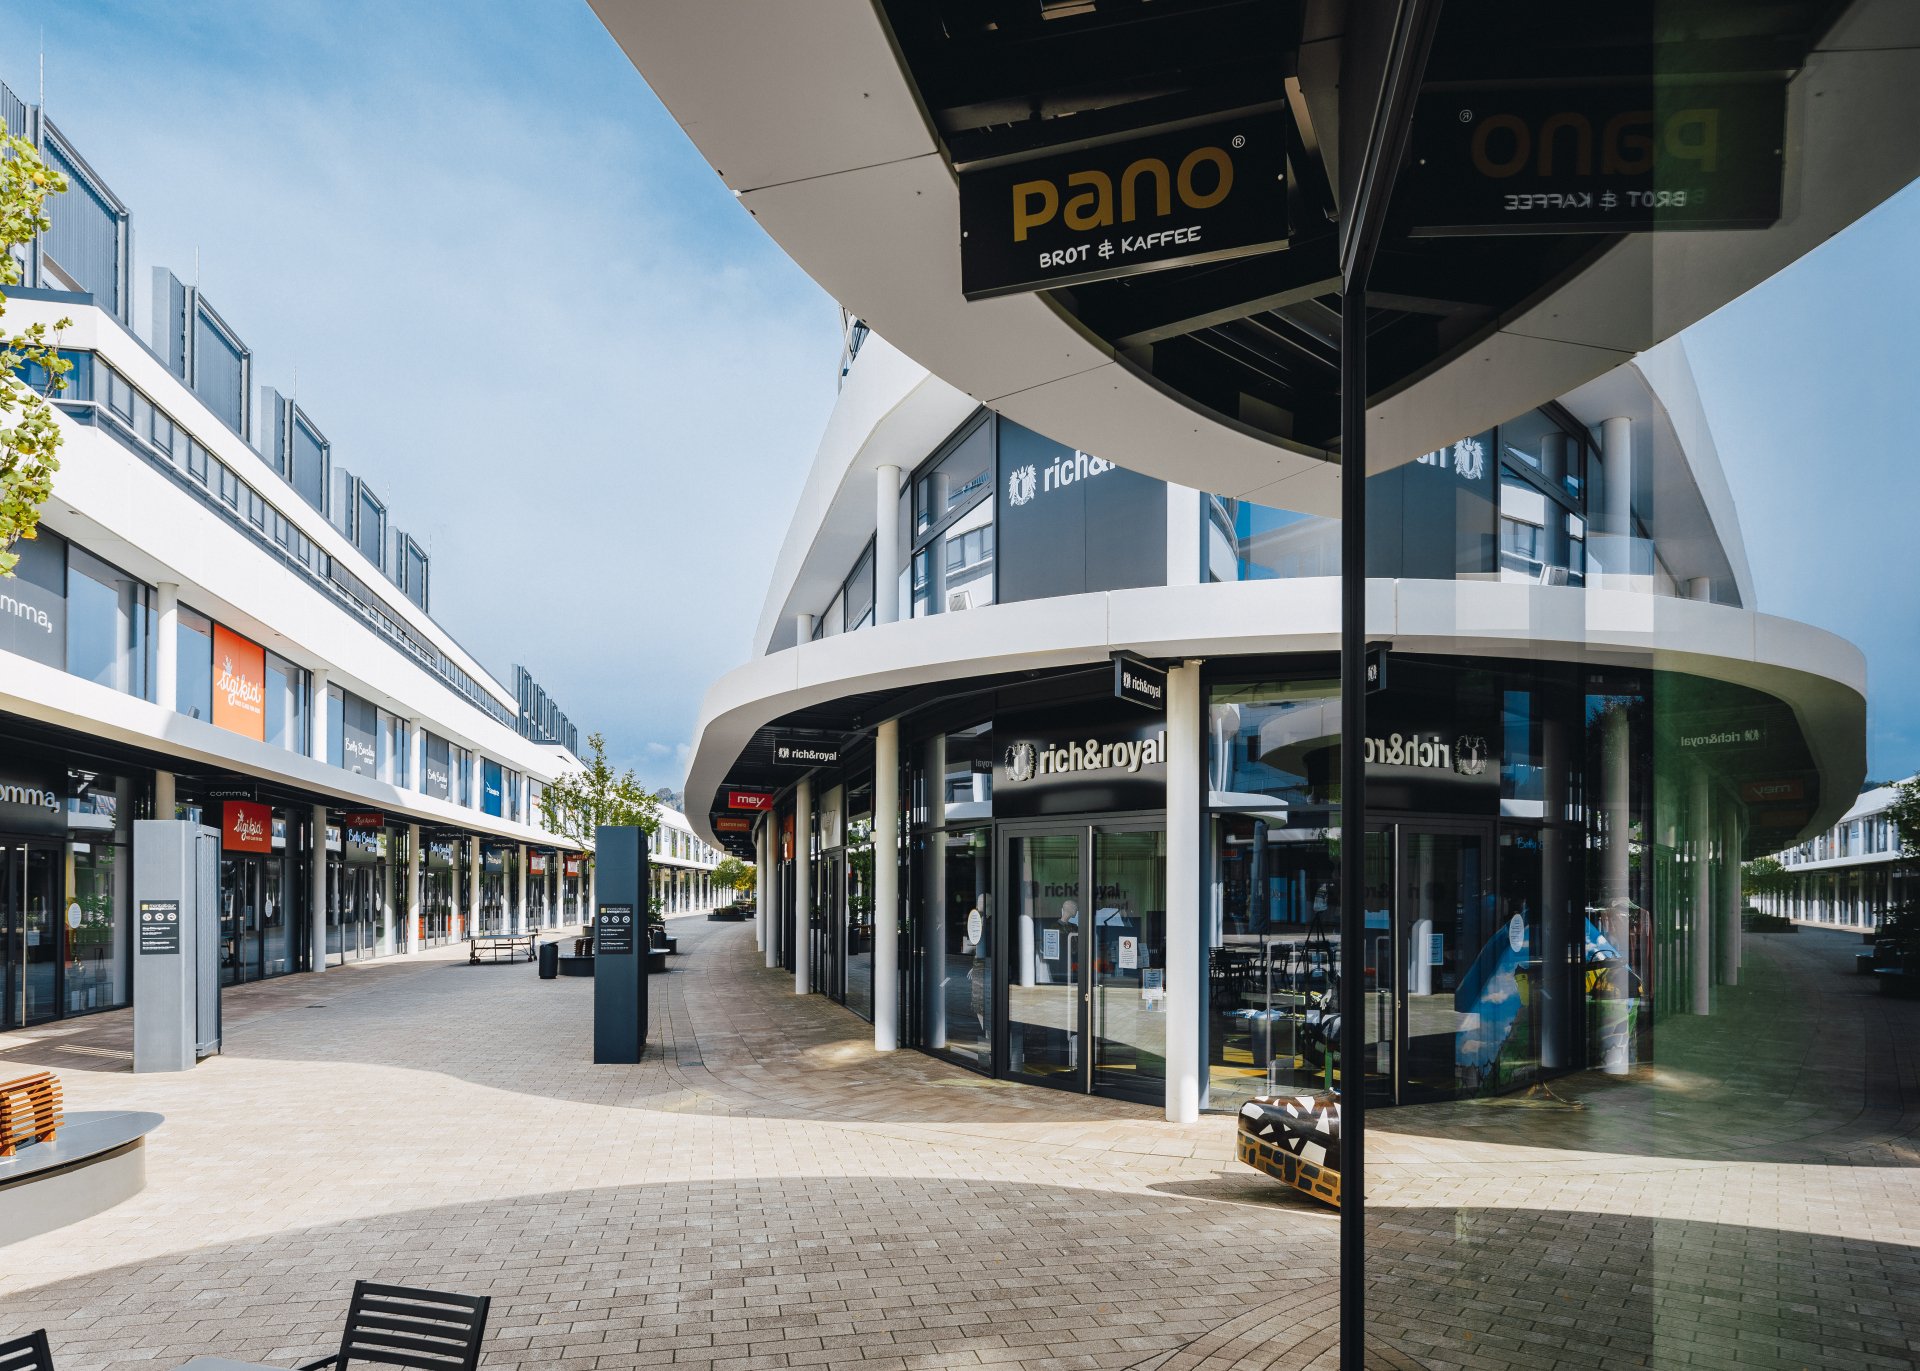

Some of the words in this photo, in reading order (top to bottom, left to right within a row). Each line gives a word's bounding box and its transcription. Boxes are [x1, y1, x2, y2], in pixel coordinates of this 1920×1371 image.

[1039, 244, 1091, 269] BROT
[1097, 239, 1115, 260] &
[1121, 225, 1202, 255] KAFFEE
[1131, 676, 1161, 699] rich&royal
[791, 748, 837, 762] rich&royal
[1039, 730, 1167, 774] rich&royal
[737, 795, 765, 808] mey
